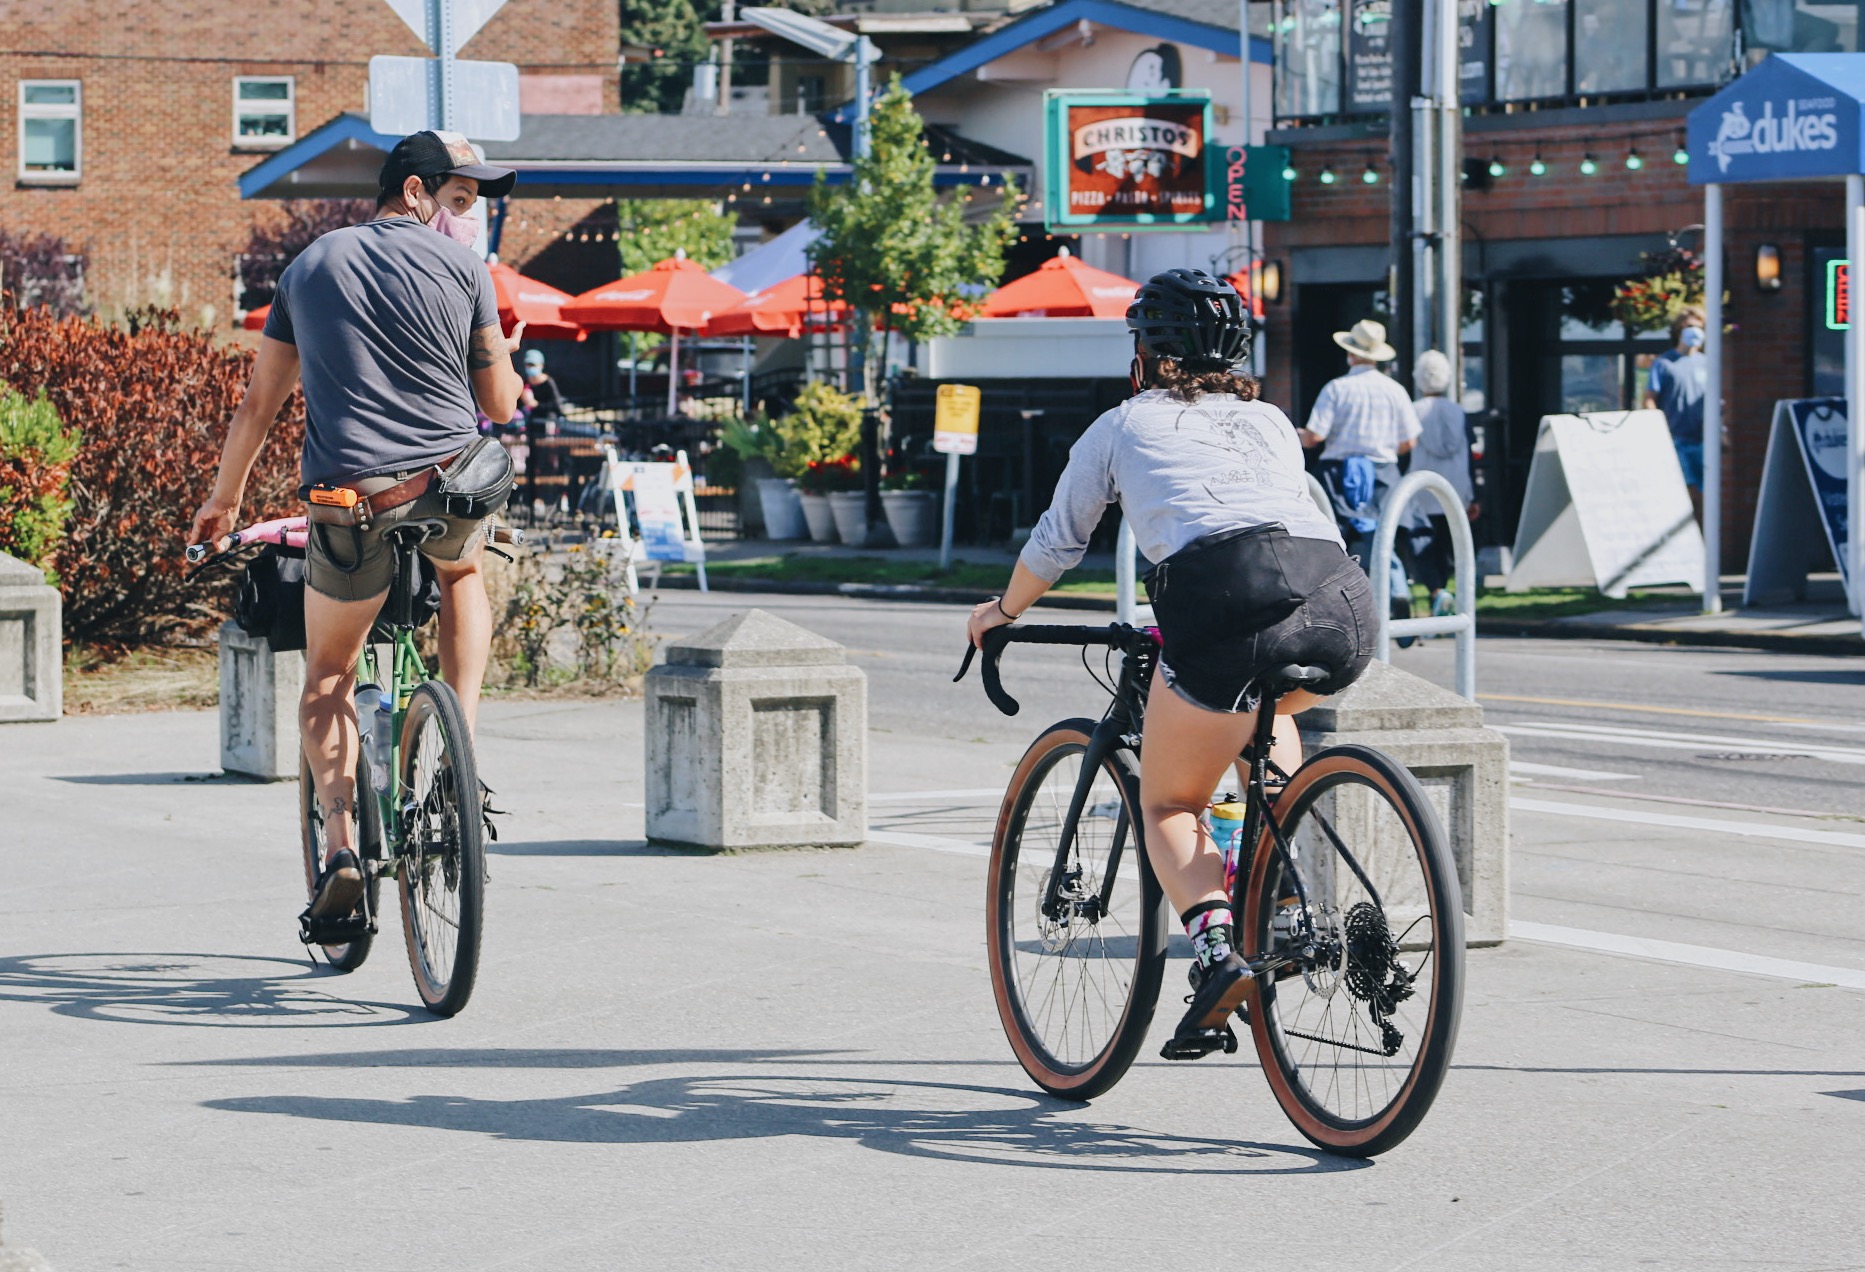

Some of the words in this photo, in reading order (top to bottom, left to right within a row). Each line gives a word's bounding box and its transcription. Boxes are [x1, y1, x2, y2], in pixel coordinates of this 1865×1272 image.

[1752, 99, 1837, 153] dukes
[1071, 190, 1105, 206] PIZZA
[1226, 146, 1248, 221] OPEN
